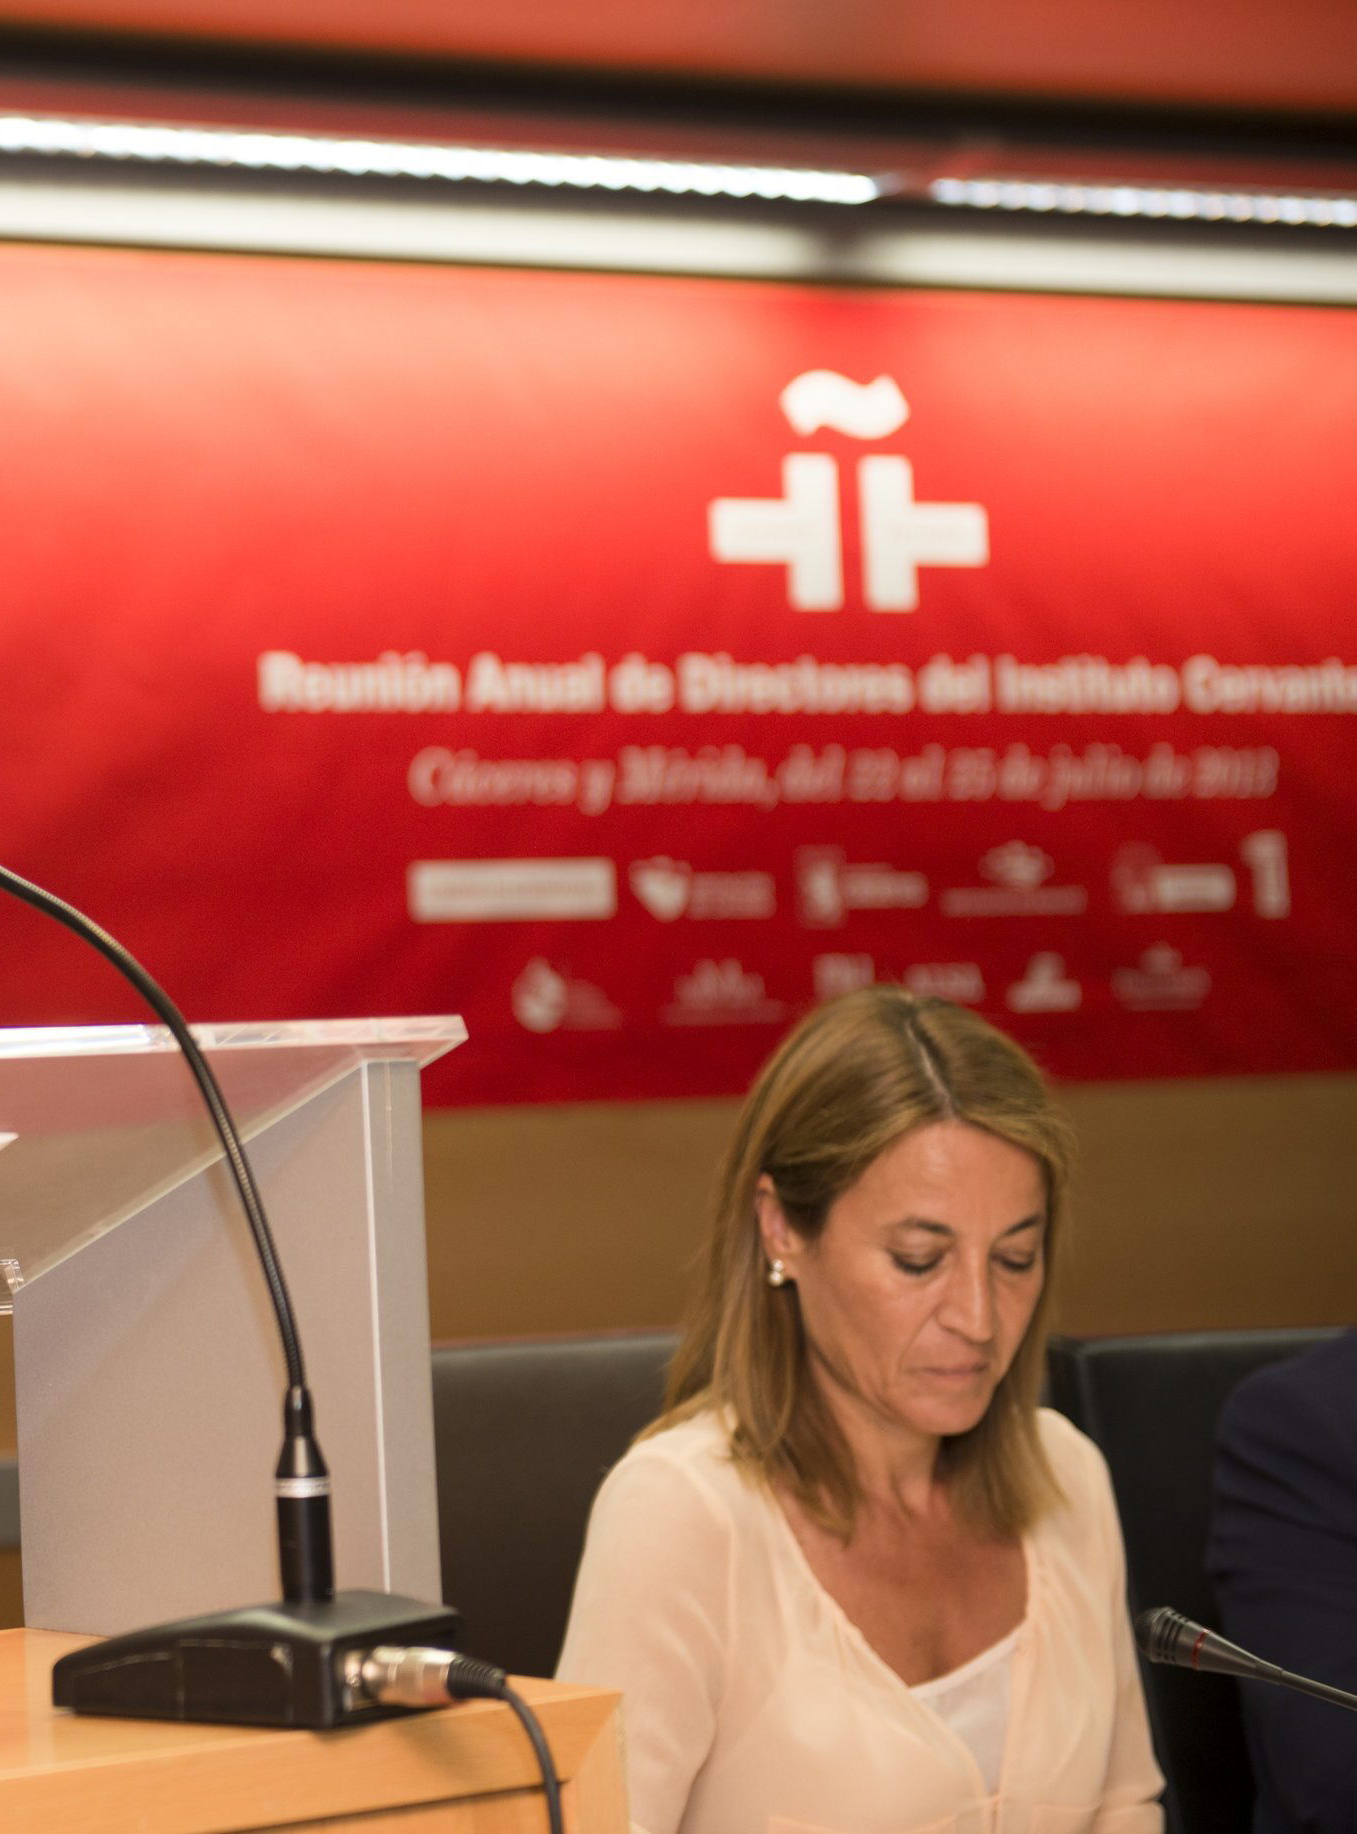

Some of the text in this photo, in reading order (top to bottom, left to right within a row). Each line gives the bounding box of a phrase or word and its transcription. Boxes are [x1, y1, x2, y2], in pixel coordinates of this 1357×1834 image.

[466, 652, 605, 713] Anual
[610, 653, 674, 713] de
[678, 652, 913, 713] Directores
[918, 653, 991, 713] del
[995, 653, 1181, 713] Instituto
